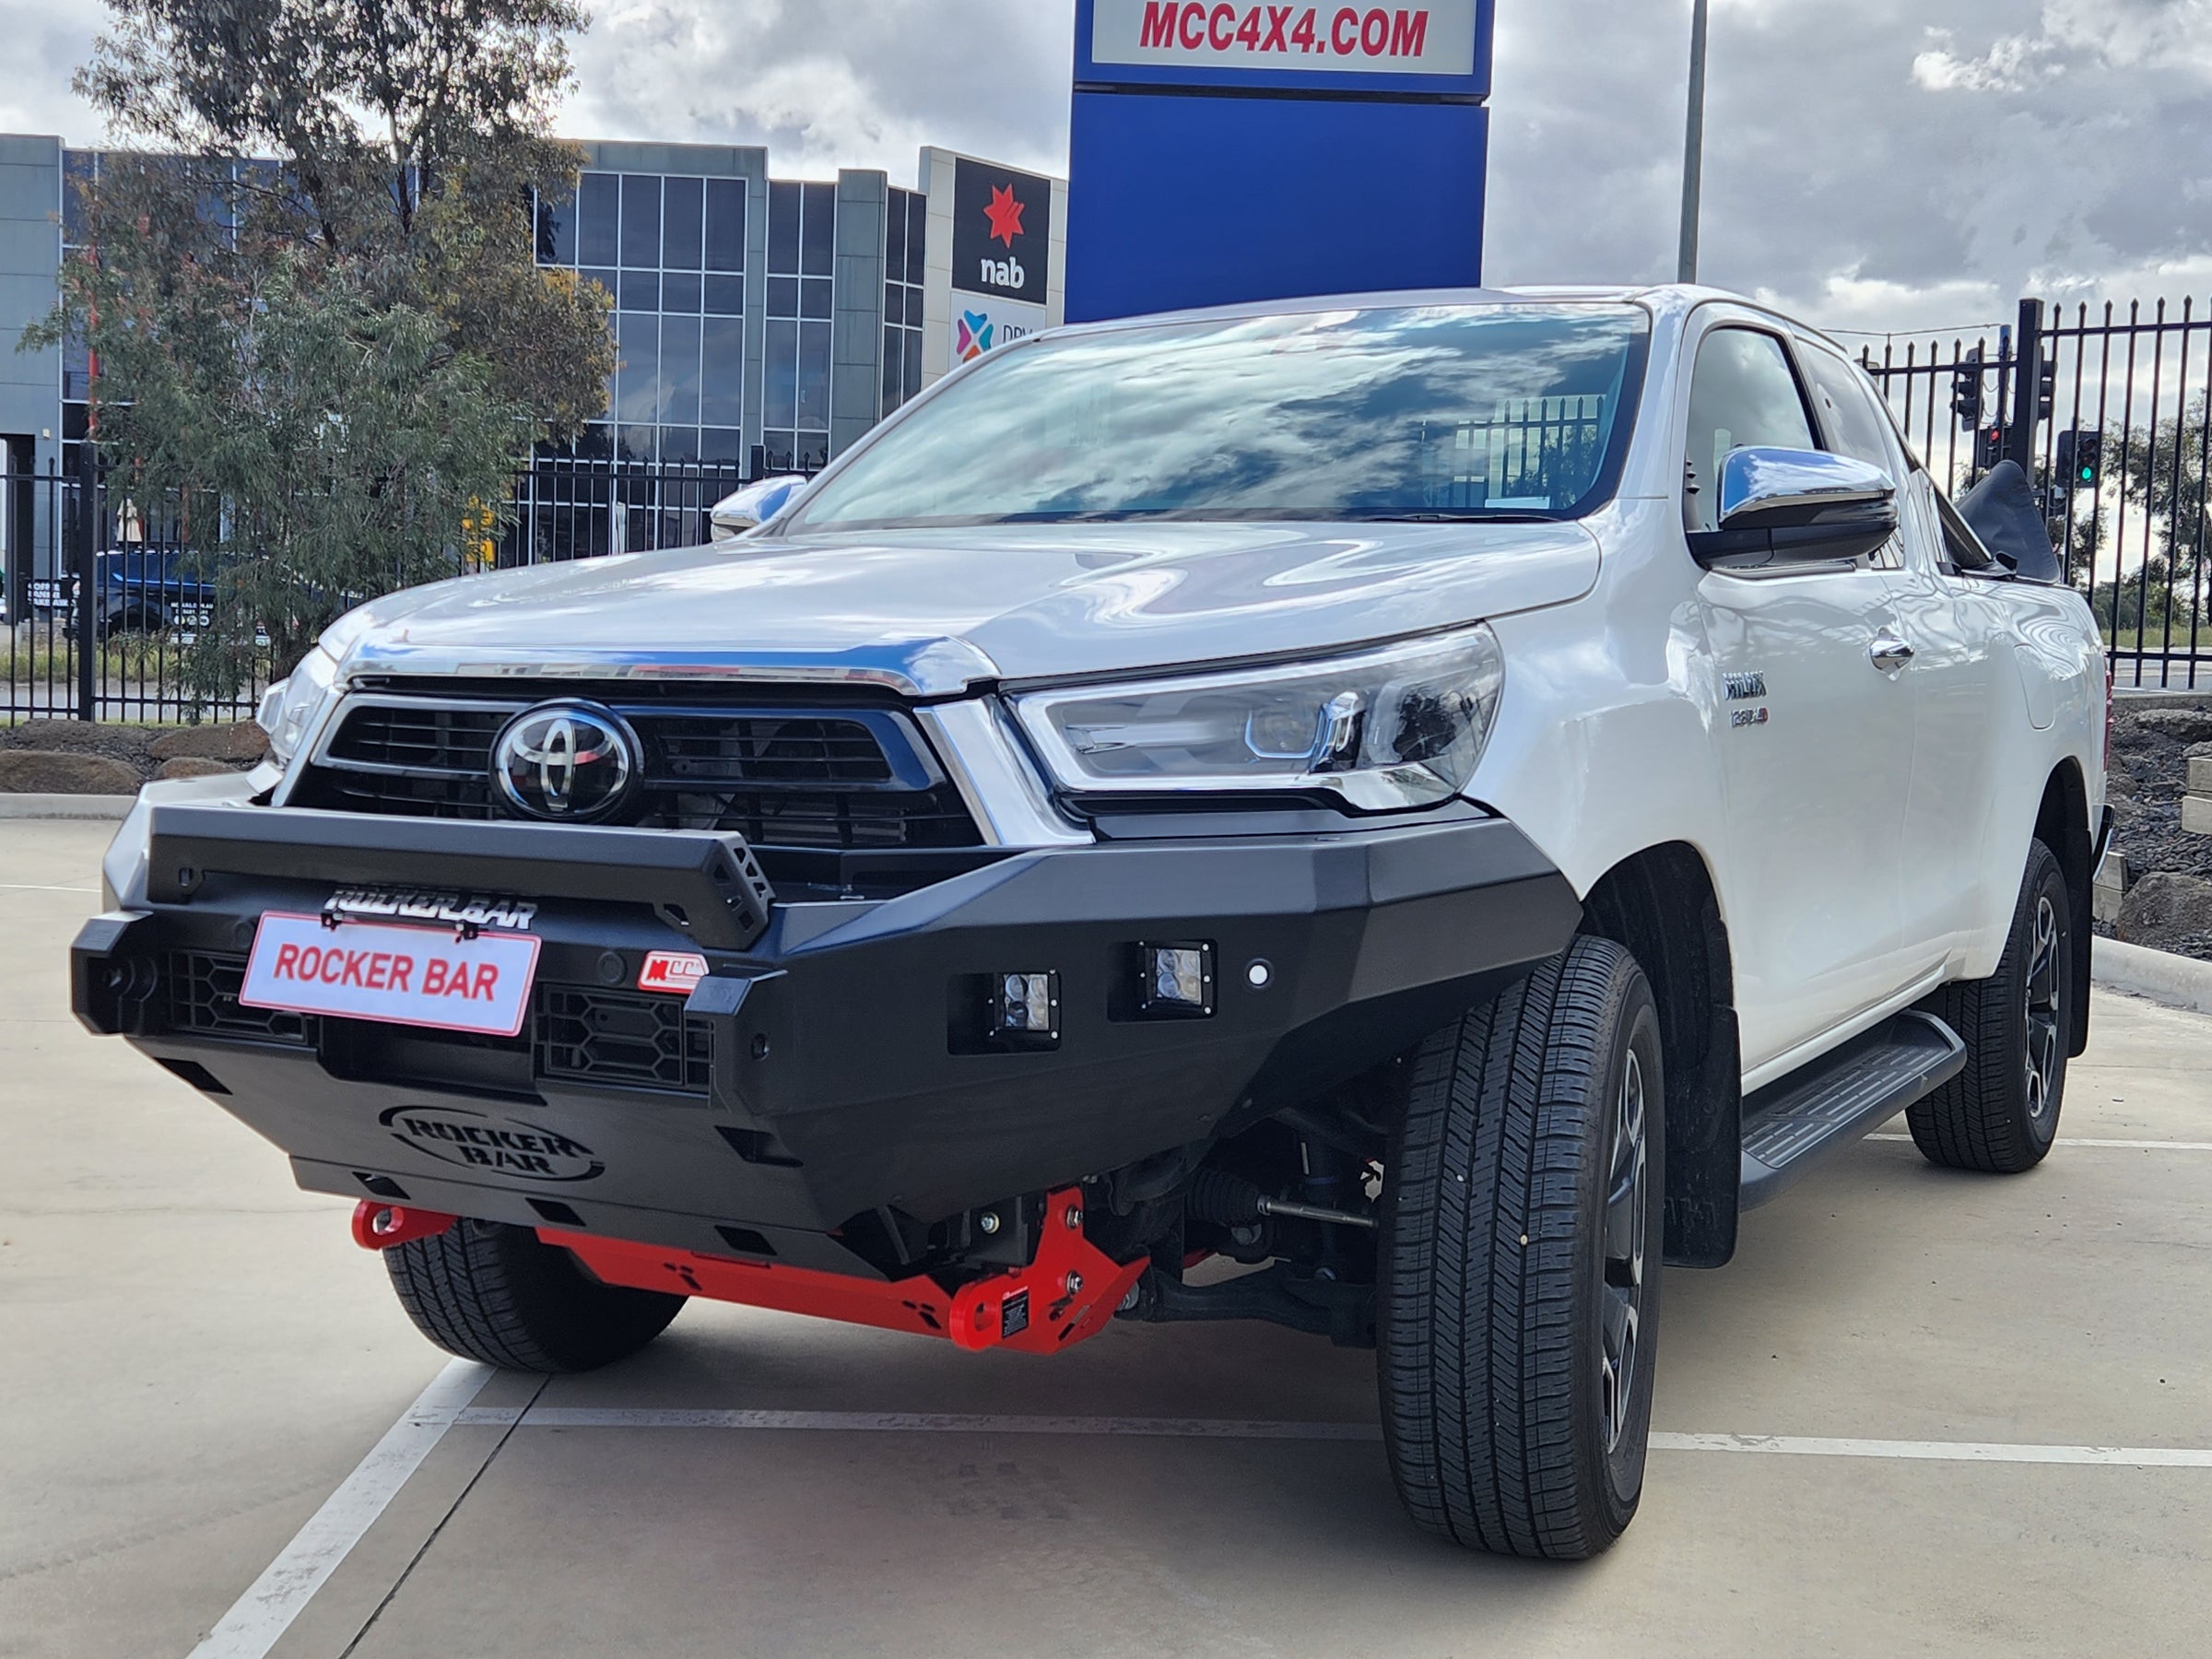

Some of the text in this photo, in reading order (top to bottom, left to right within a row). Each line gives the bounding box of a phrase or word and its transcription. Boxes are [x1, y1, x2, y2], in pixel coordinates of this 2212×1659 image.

[1139, 1, 1430, 57] MCC4X4.COM
[981, 256, 1025, 288] nab
[1003, 324, 1033, 344] DP
[461, 894, 539, 930] BAR
[273, 943, 500, 1002] ROCKER BAR
[402, 1117, 581, 1159] ROCKER
[457, 1145, 558, 1175] BAR
